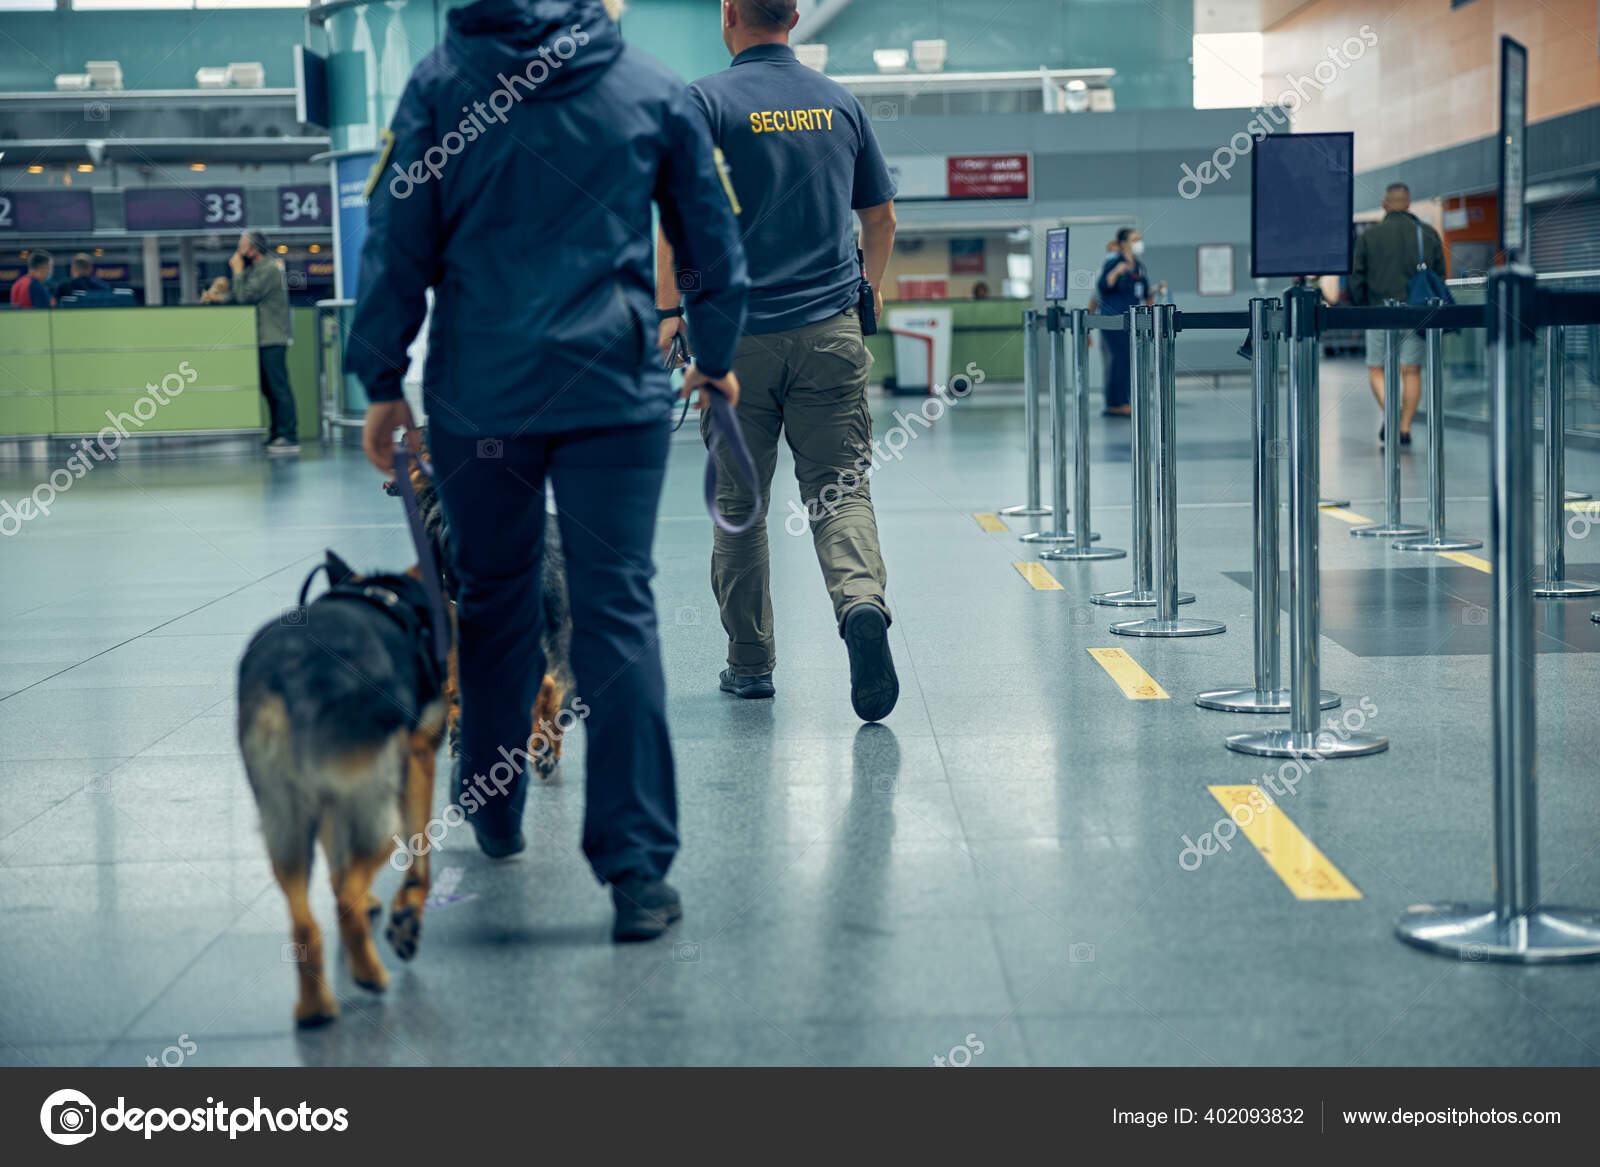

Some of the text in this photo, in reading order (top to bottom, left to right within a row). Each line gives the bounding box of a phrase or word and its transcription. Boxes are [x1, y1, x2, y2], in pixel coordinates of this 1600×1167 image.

[750, 109, 832, 133] SECURITY
[204, 193, 242, 223] 33
[282, 192, 320, 221] 34
